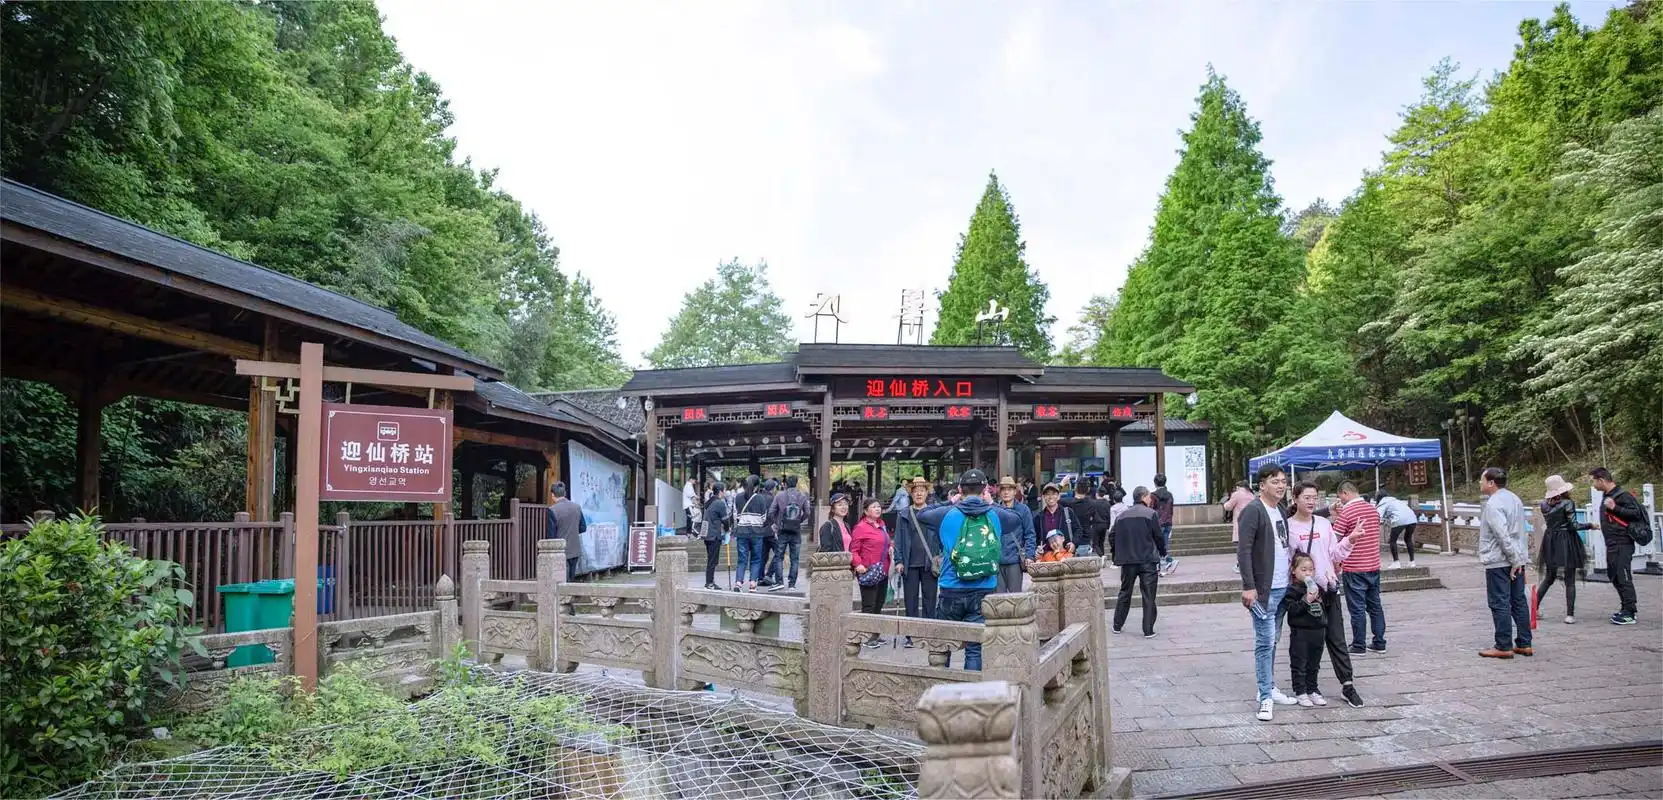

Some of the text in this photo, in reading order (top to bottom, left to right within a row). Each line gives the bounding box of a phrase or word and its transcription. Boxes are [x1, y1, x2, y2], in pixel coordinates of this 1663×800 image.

[866, 379, 973, 397] 迎仙桥入口
[340, 441, 434, 465] 迎仙桥站
[343, 464, 430, 475] Yingxianqiao Station
[369, 476, 406, 487] 영선교역
